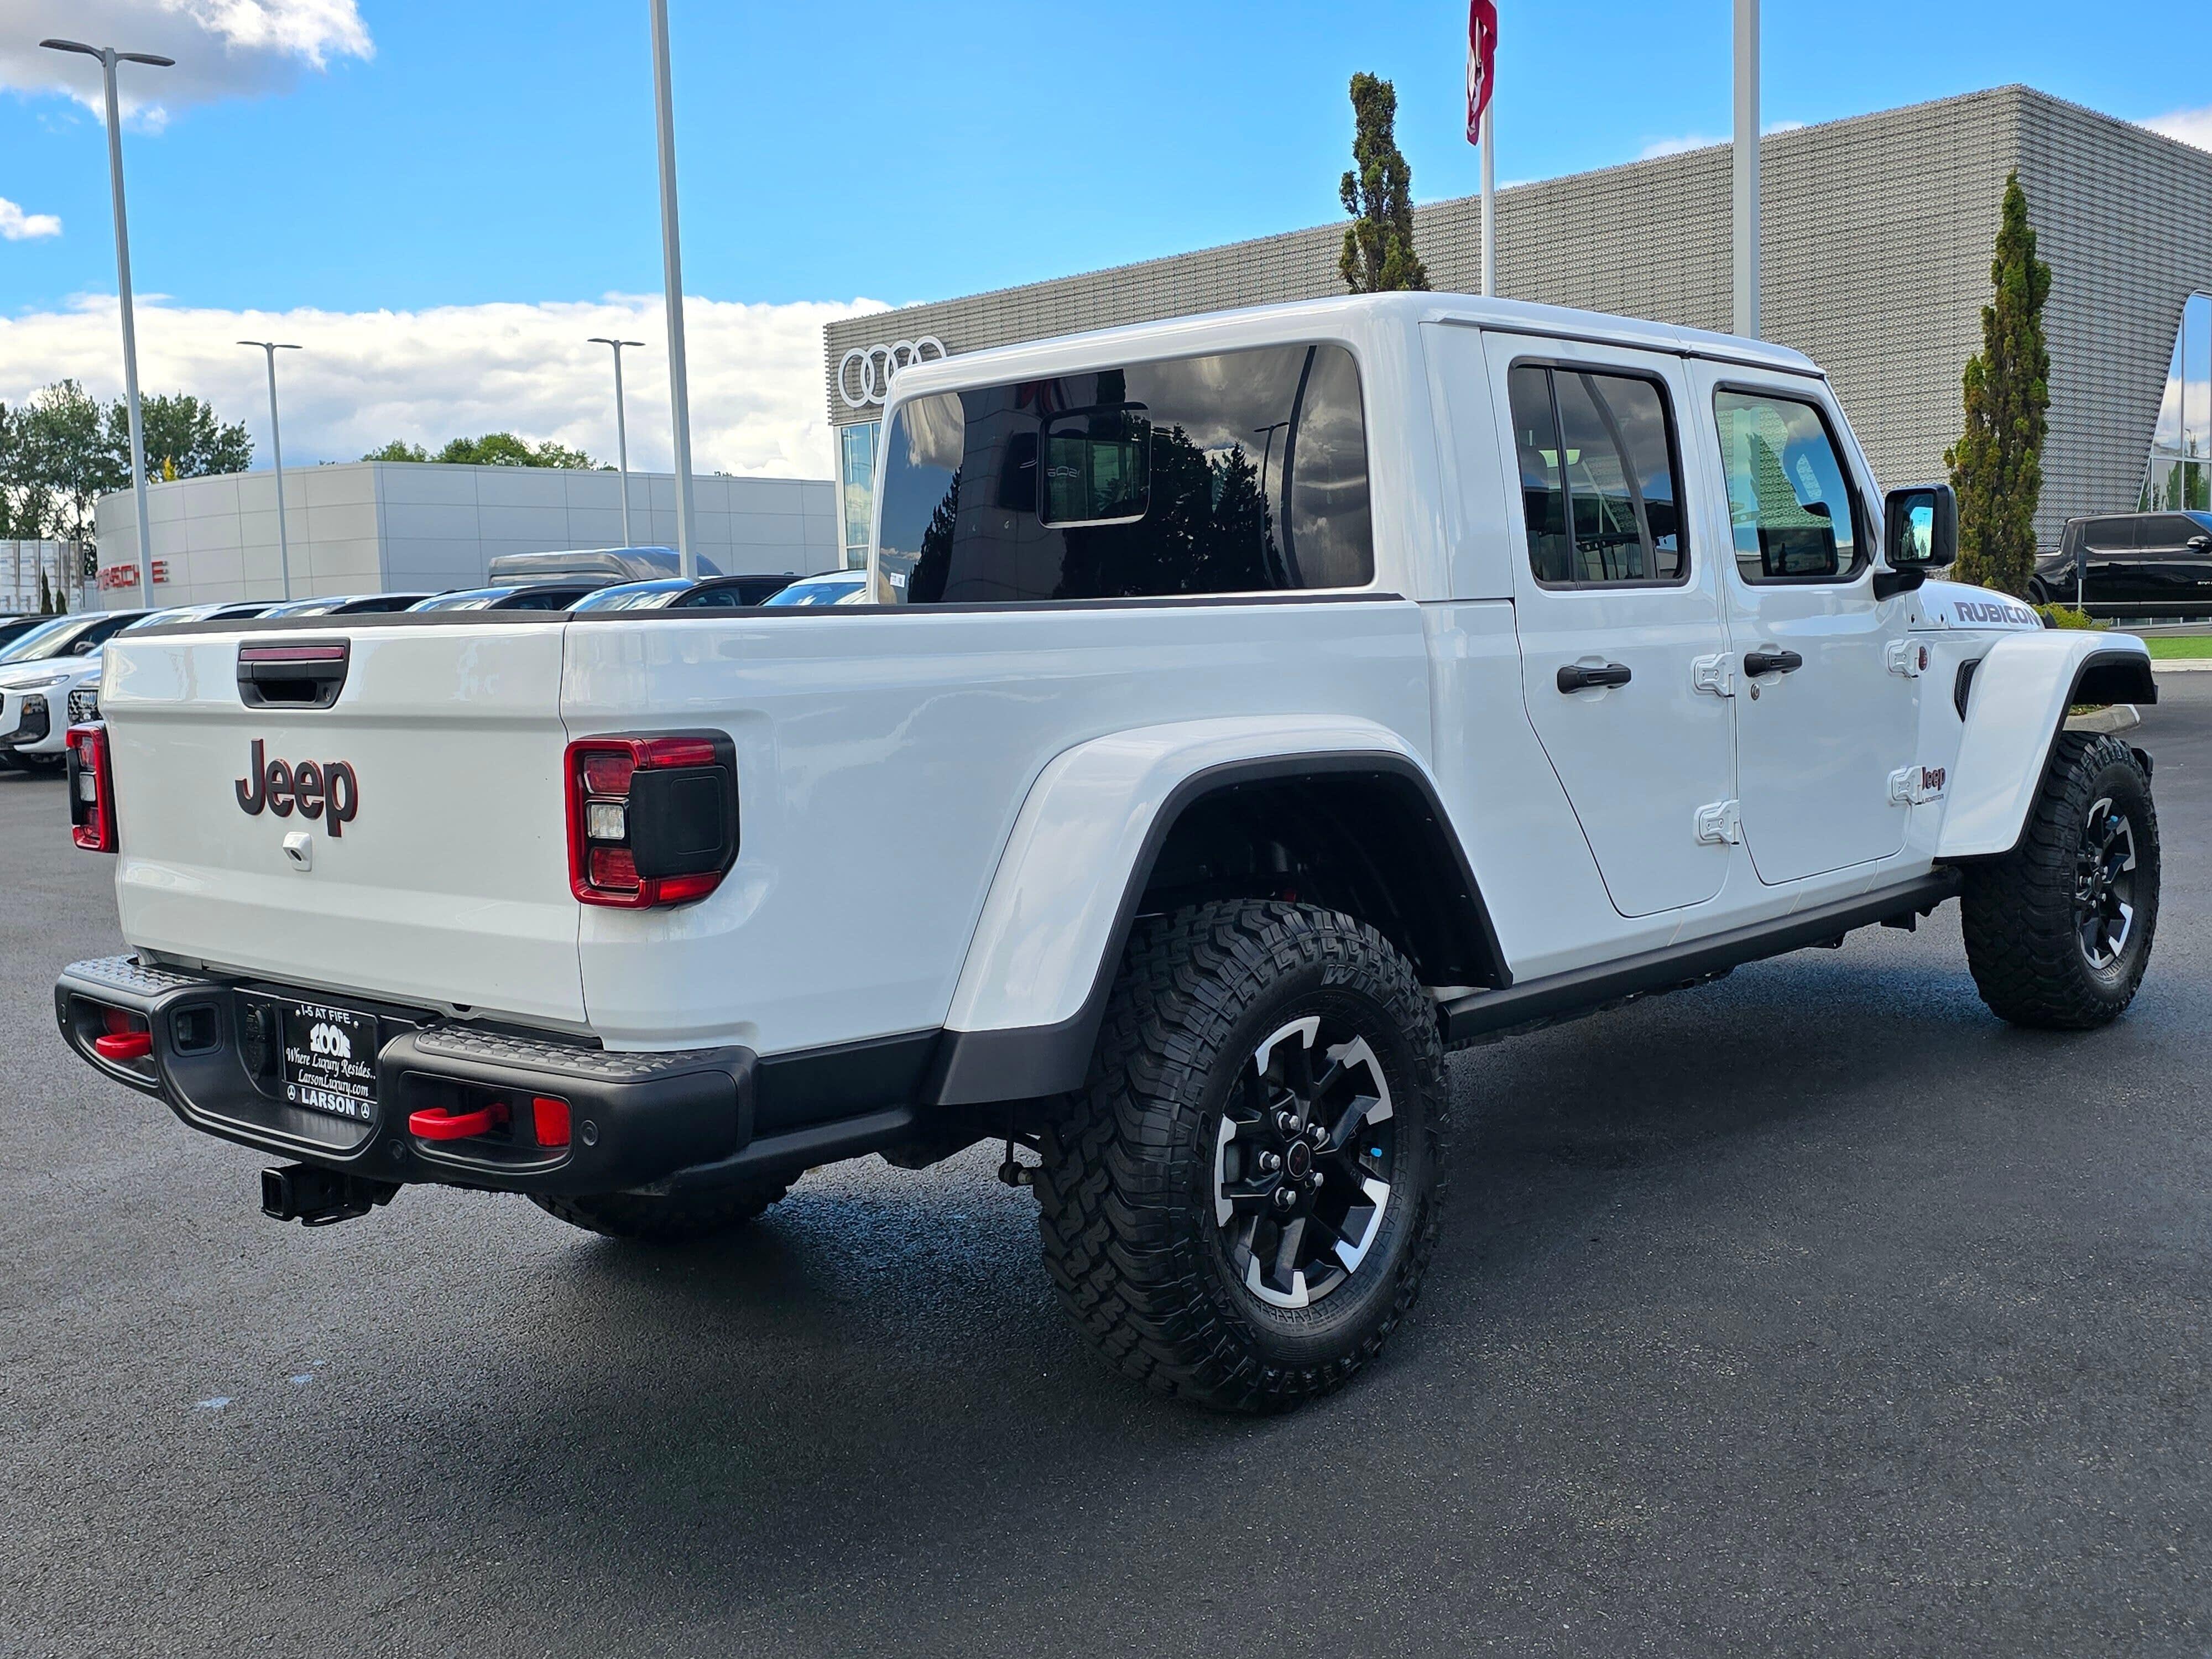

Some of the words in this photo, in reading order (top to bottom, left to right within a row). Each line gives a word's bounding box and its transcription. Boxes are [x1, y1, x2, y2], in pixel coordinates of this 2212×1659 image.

[1953, 602, 2040, 626] RUBICON
[235, 738, 358, 837] Jeep
[1922, 766, 1945, 791] Jeep
[301, 1004, 313, 1016] I-5
[315, 1008, 326, 1019] AT
[328, 1011, 351, 1024] FIFE
[286, 1047, 310, 1065] Where
[312, 1053, 340, 1077] Luxury
[298, 1069, 369, 1097] LarsonLuxury.com
[301, 1088, 356, 1116] LARSON
